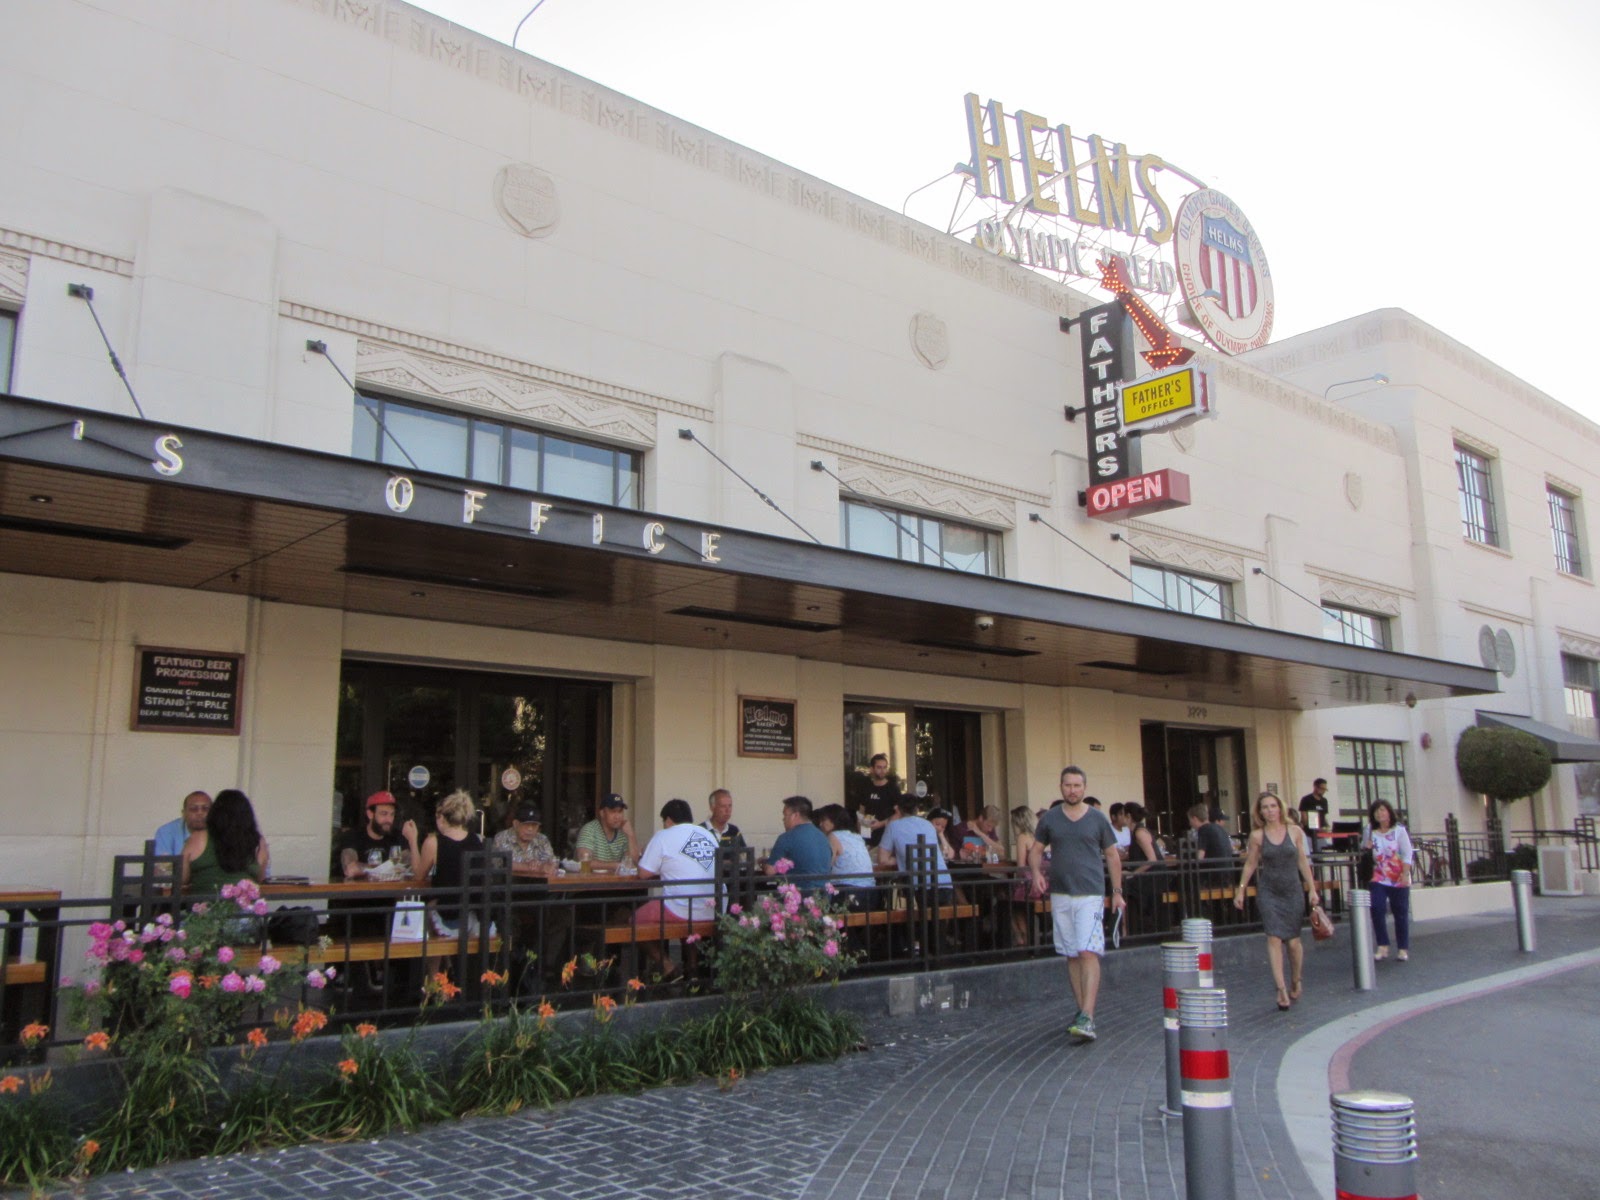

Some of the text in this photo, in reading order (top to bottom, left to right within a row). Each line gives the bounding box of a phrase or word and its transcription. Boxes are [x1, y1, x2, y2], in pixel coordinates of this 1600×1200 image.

[964, 92, 1173, 246] HELMS
[976, 218, 1092, 277] OLYMPIC
[1208, 226, 1244, 254] HELMS
[1201, 314, 1213, 329] OF
[1089, 312, 1119, 476] FATHERS
[1132, 379, 1182, 406] FATHER'S
[1140, 397, 1175, 414] OFFICE
[1092, 474, 1162, 511] OPEN
[385, 475, 721, 563] OFFICE
[153, 656, 232, 670] FEATURED BEER
[156, 667, 230, 681] PROGRESSION
[144, 696, 185, 707] STRAND
[204, 700, 229, 710] PALE
